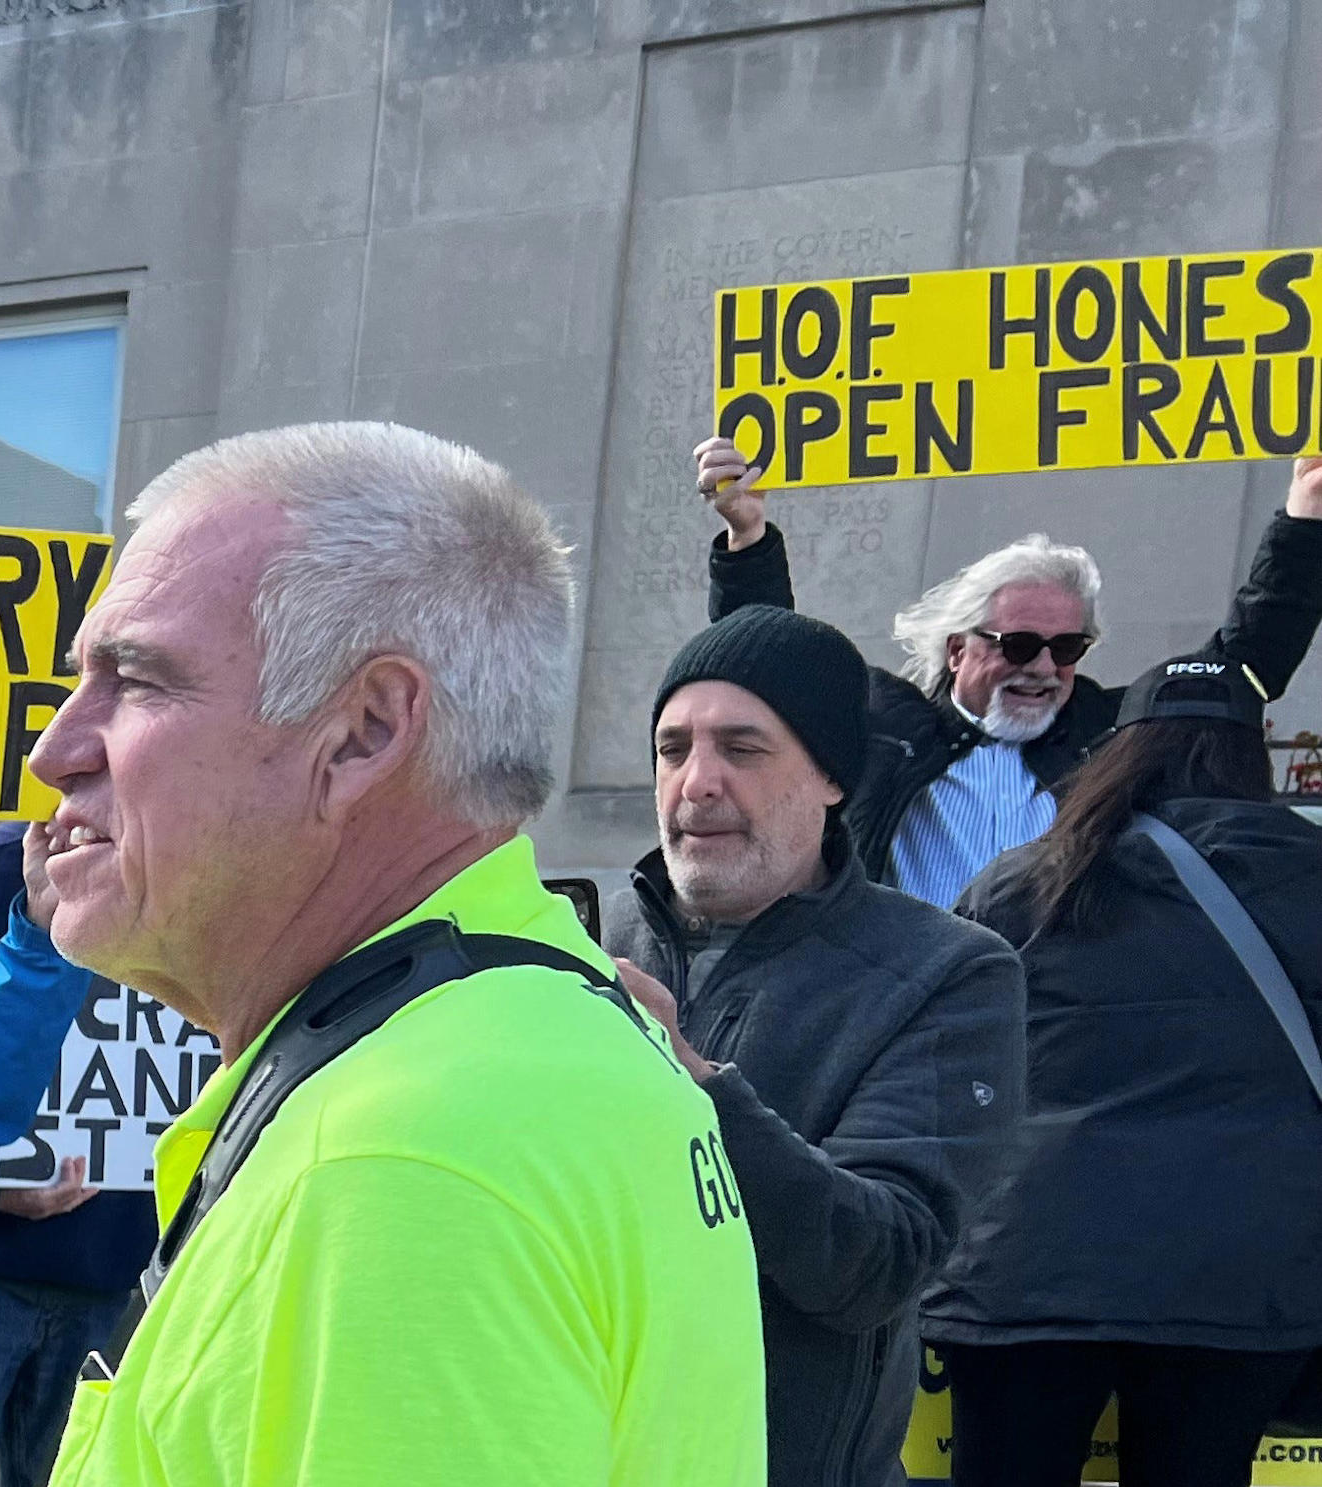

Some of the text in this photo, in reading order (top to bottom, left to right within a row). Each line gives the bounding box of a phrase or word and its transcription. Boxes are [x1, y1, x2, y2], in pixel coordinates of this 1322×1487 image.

[989, 252, 1314, 370] HONES
[718, 356, 1322, 482] OPEN FRAU
